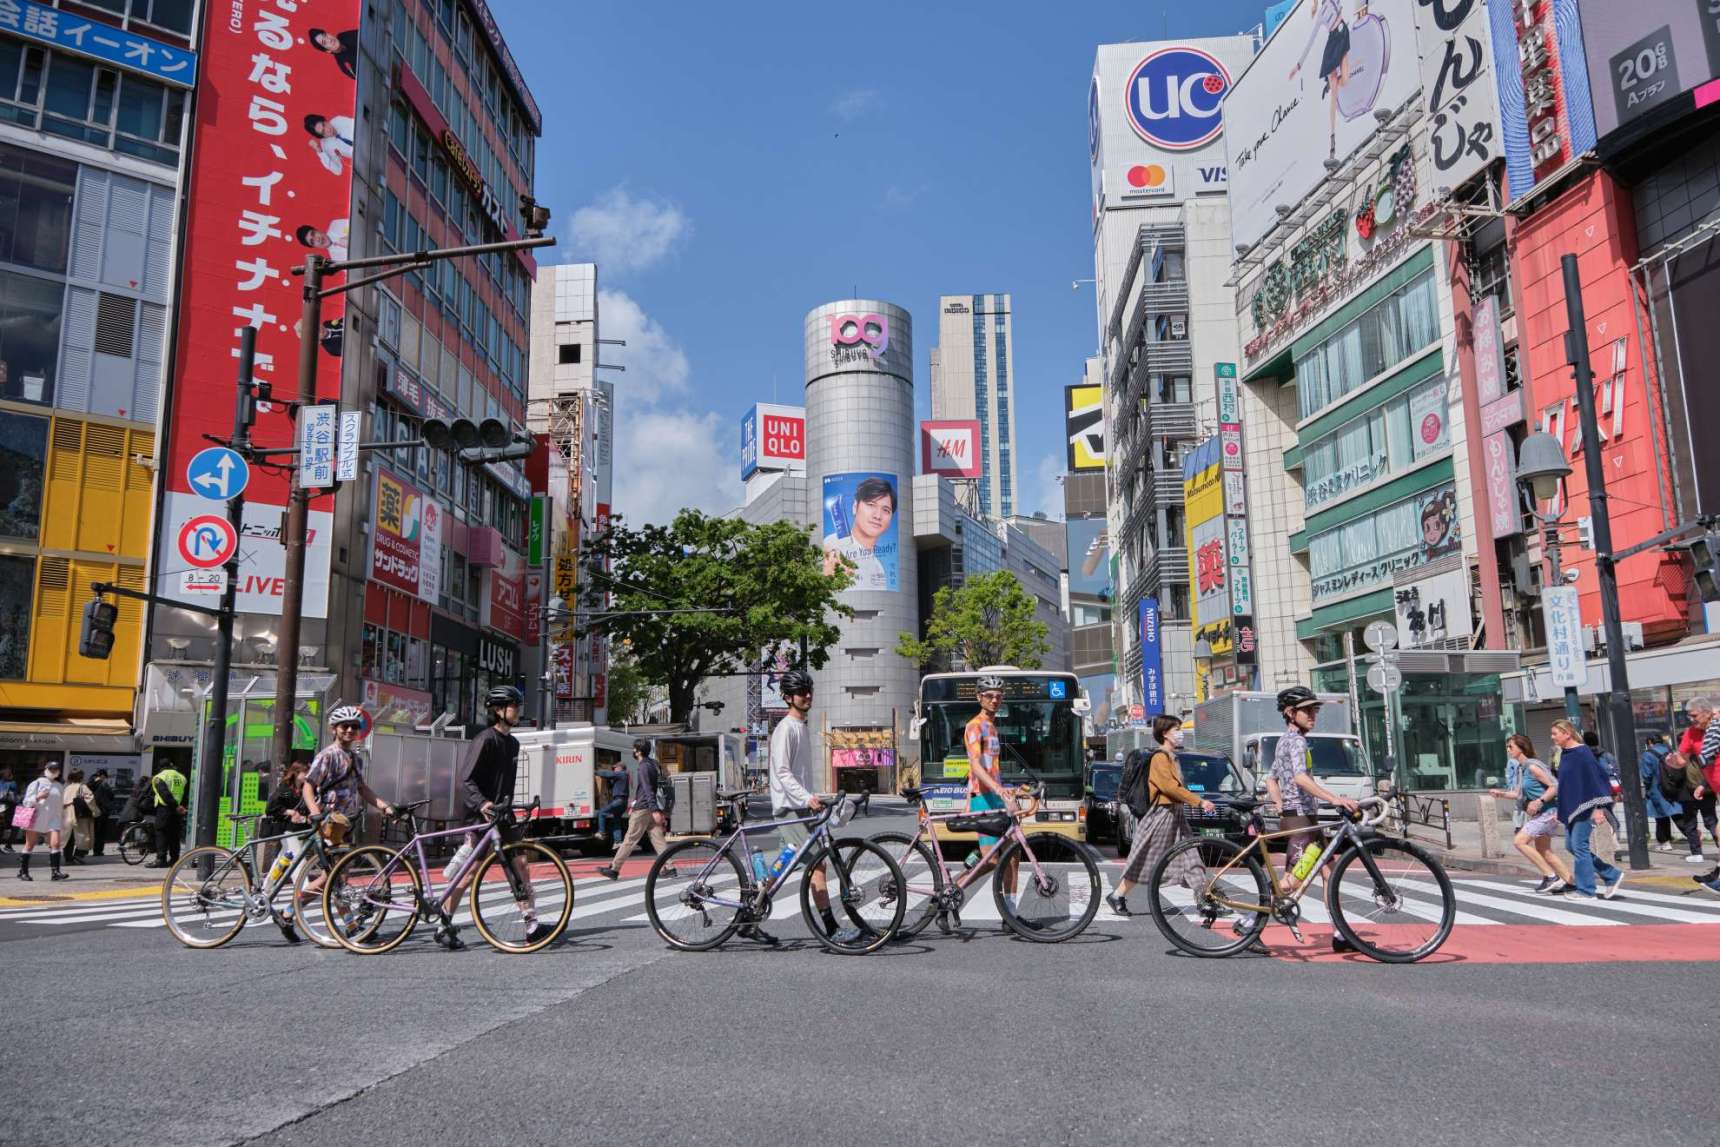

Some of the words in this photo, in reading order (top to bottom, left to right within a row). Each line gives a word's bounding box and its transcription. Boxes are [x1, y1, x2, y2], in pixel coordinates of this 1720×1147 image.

[1627, 80, 1665, 110] Aプラン
[1235, 147, 1252, 171] Take
[1199, 167, 1227, 183] VIS
[767, 419, 799, 437] UNI
[315, 411, 331, 481] 渋谷駅前
[767, 437, 801, 455] QLO
[936, 439, 967, 459] H&M
[380, 482, 400, 530] 薬
[846, 550, 858, 559] Are
[859, 546, 872, 556] You
[873, 542, 897, 555] Ready?
[375, 548, 419, 582] サンドラッグ
[1198, 537, 1224, 593] 薬
[1146, 607, 1156, 643] MIZUHO
[1551, 594, 1570, 671] 文化村通り
[480, 640, 513, 679] LUSH
[152, 735, 194, 743] SHIBUY
[555, 754, 583, 765] KIRIN
[953, 786, 968, 794] BUS
